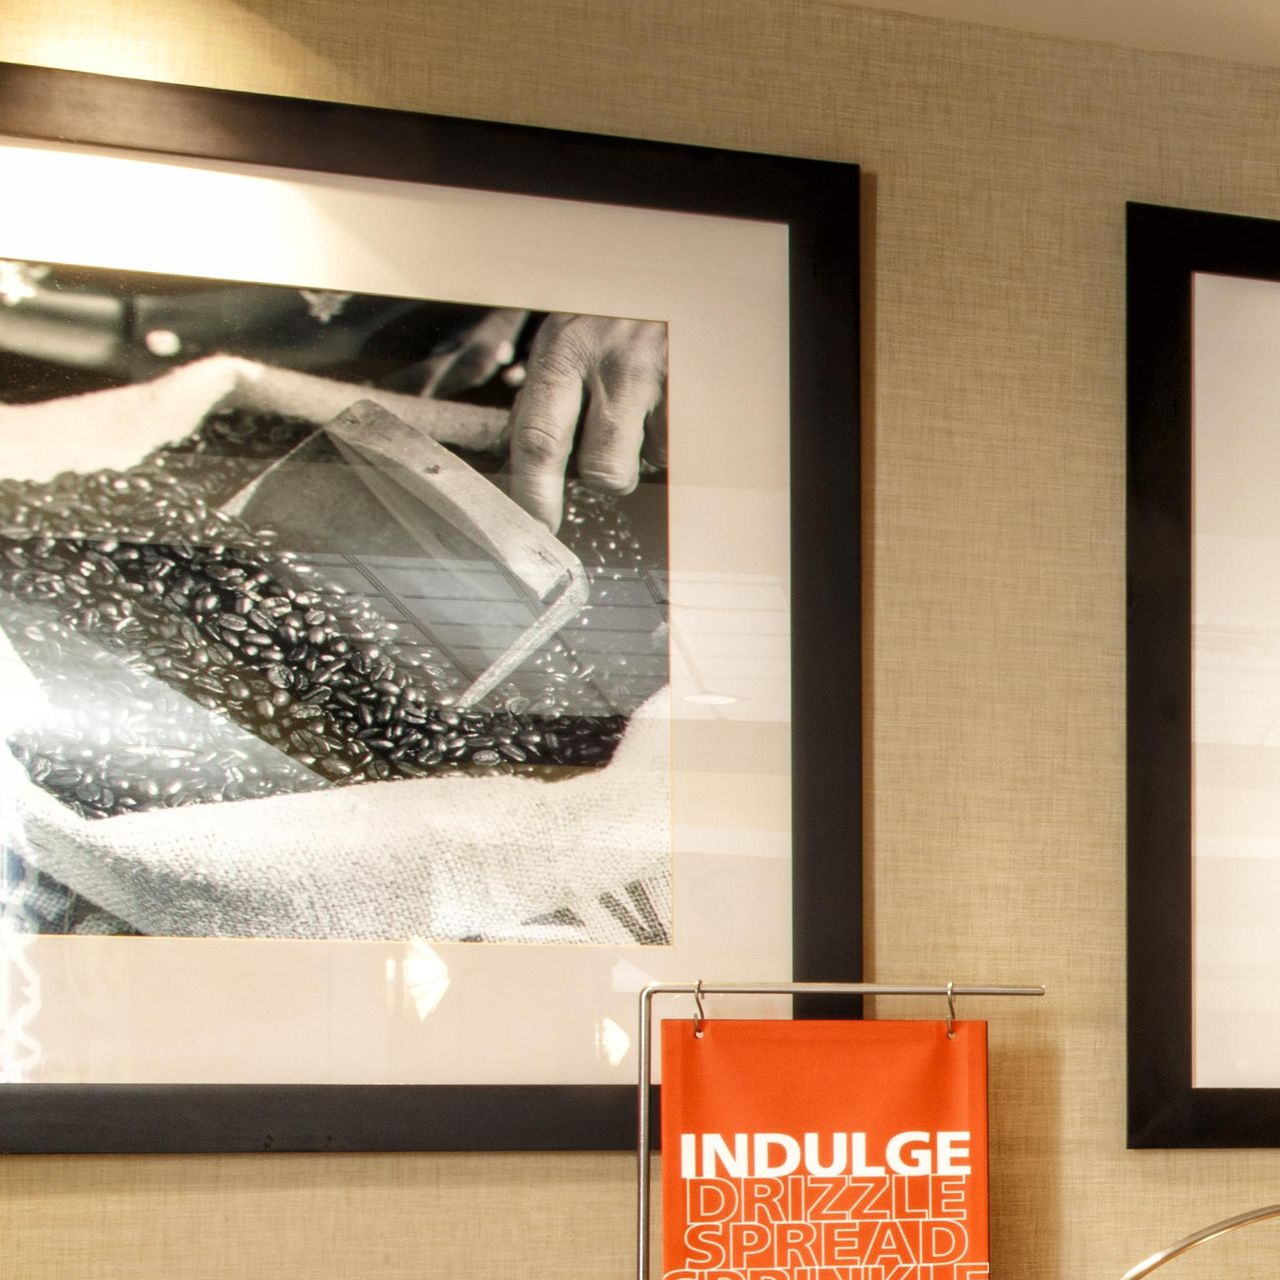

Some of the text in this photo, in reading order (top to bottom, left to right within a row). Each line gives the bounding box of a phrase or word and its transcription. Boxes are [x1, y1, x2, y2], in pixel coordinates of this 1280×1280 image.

[680, 1131, 972, 1179] INDULGE
[686, 1174, 967, 1225] DRIZZLE
[684, 1219, 969, 1270] SPREAD
